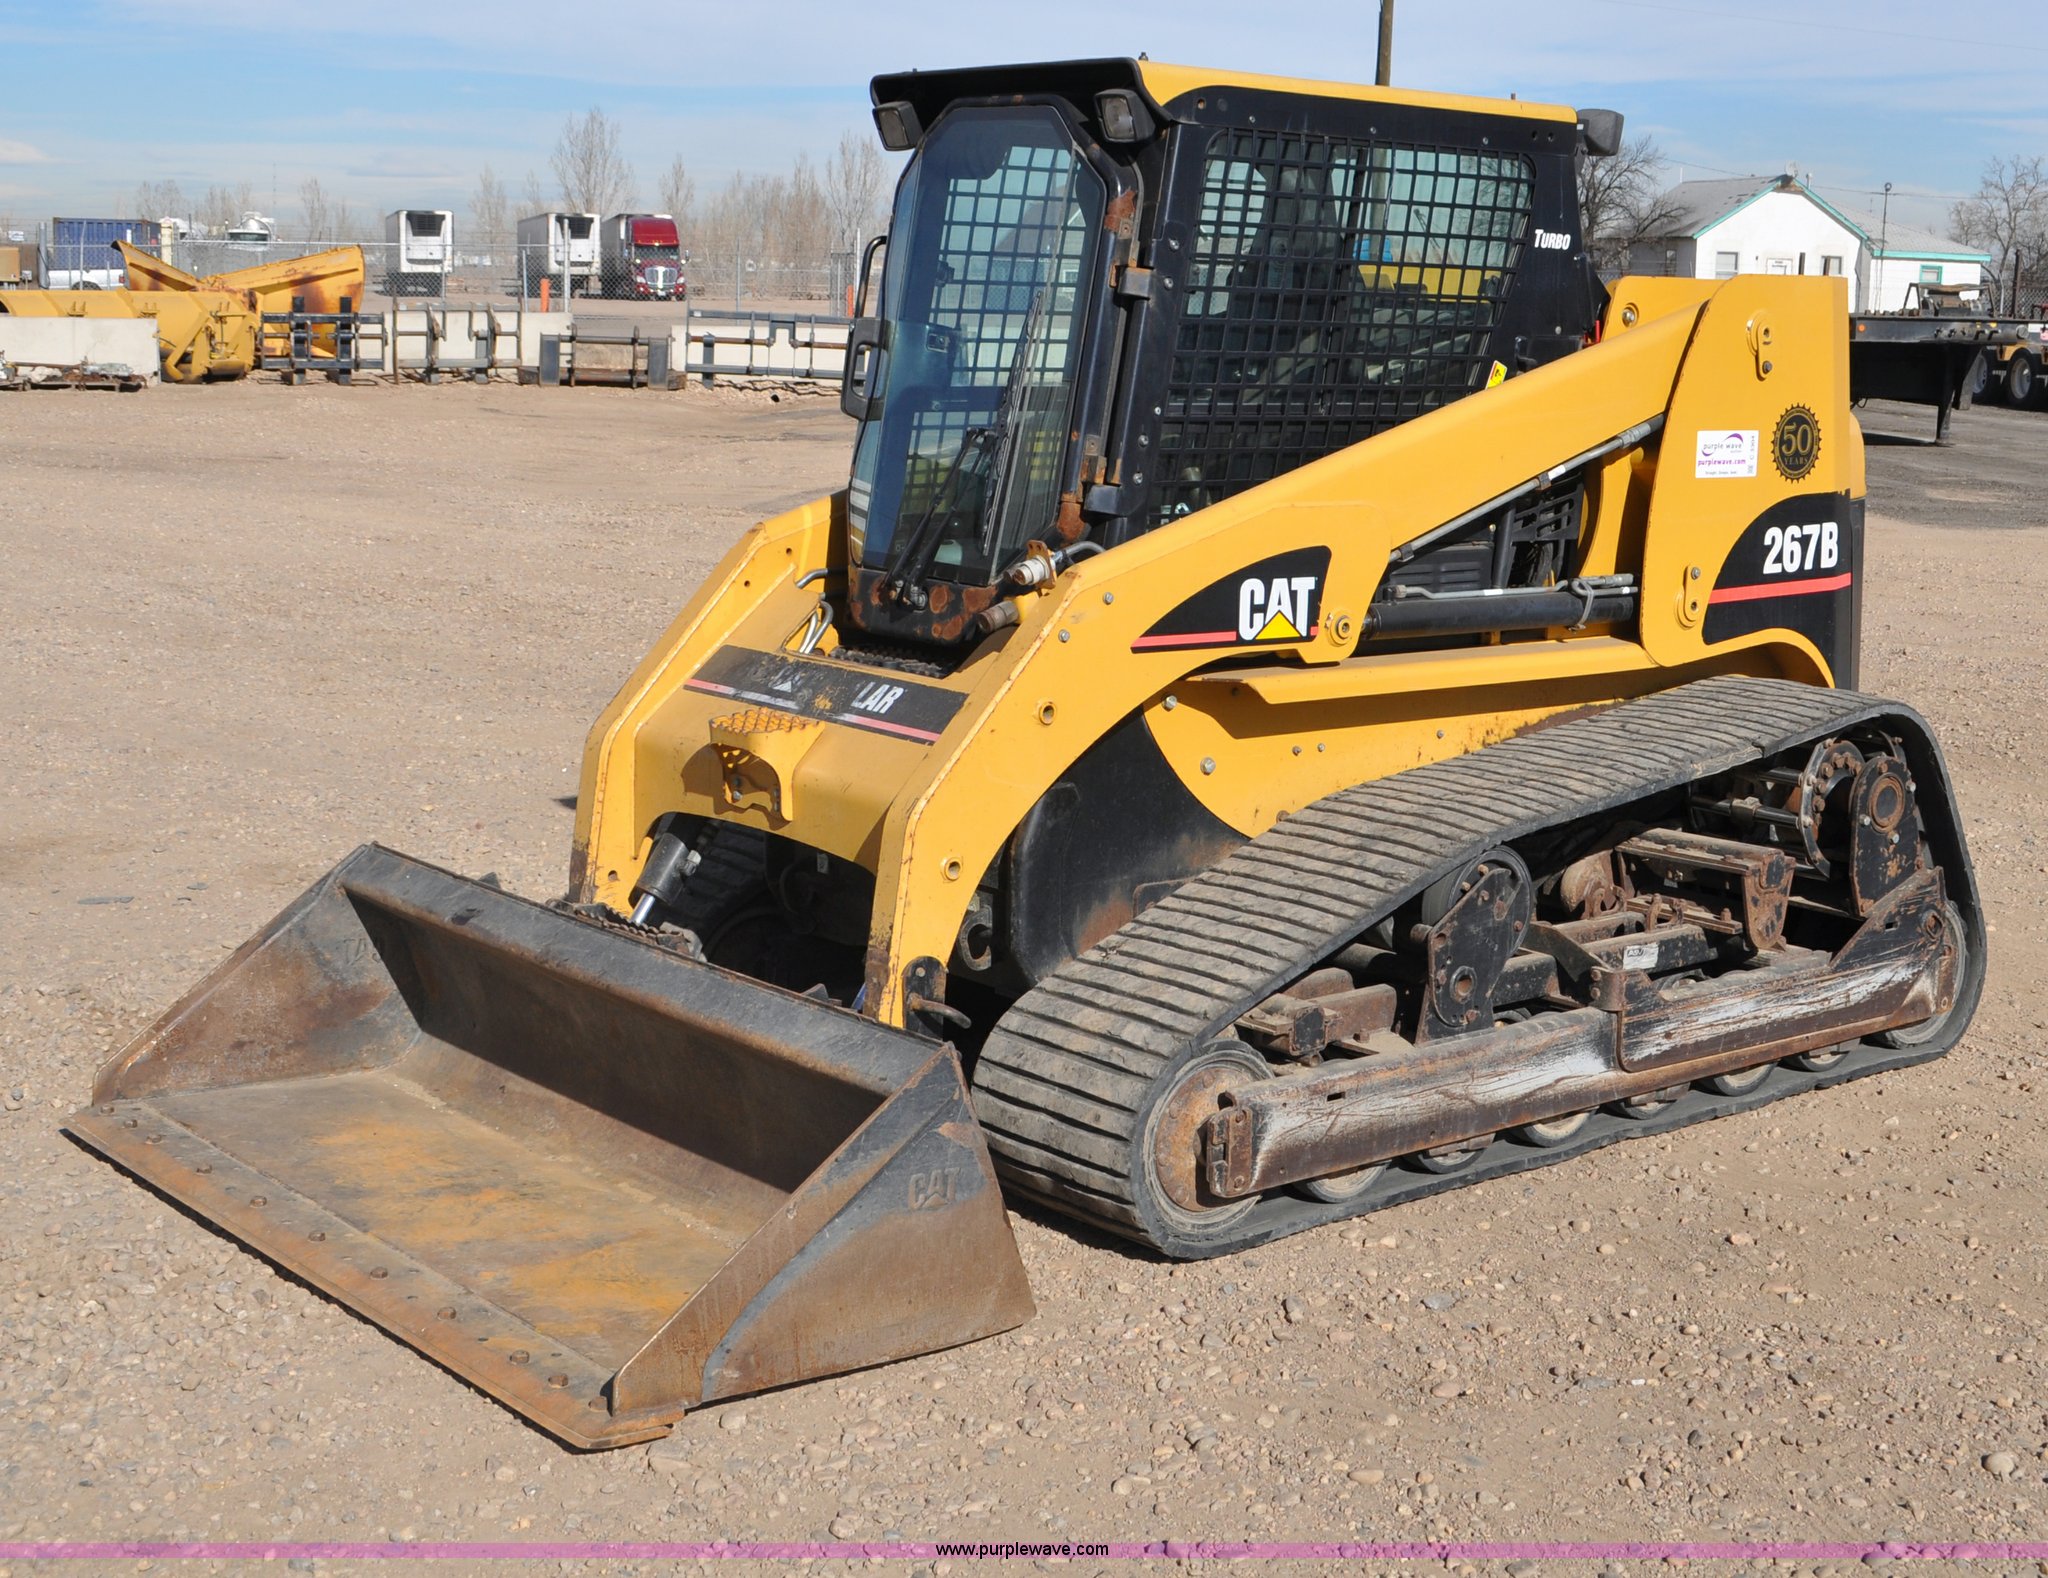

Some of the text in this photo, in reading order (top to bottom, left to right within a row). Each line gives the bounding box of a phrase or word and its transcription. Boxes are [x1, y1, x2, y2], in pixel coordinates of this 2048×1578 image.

[1534, 228, 1571, 251] TURBO
[1703, 442, 1724, 451] purple
[1782, 422, 1812, 456] 50
[1698, 459, 1746, 467] purplewave.com
[1784, 456, 1809, 465] YEARS
[1763, 521, 1839, 575] 267B
[1238, 576, 1317, 641] CAT
[907, 1167, 962, 1210] CAT
